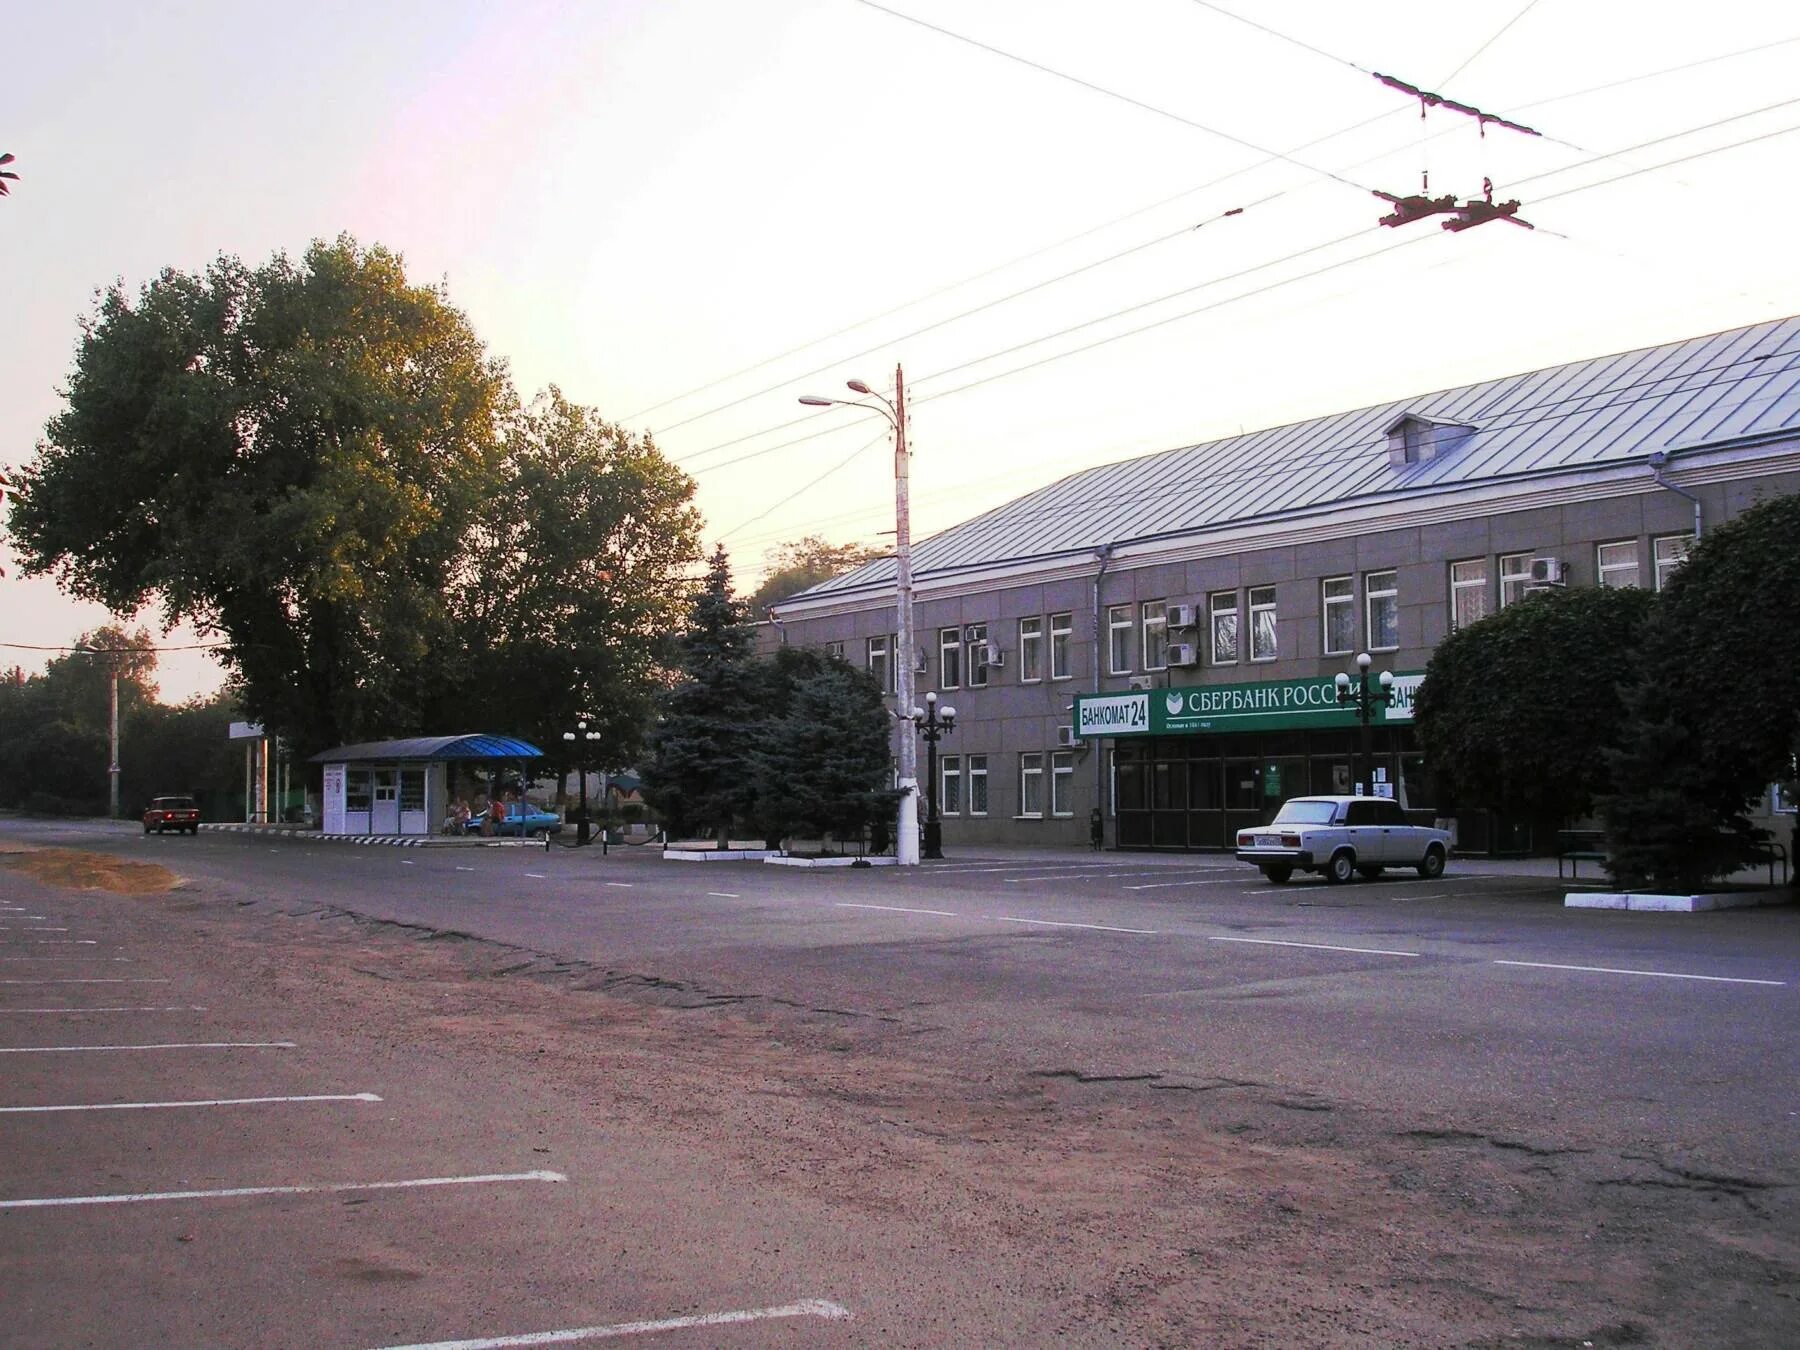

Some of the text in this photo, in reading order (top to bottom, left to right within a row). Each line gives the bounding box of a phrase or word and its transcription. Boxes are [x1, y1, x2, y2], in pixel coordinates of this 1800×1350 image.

[1189, 688, 1280, 712] СБЕРБАНК
[1082, 700, 1146, 726] БАНКОМАТ 24
